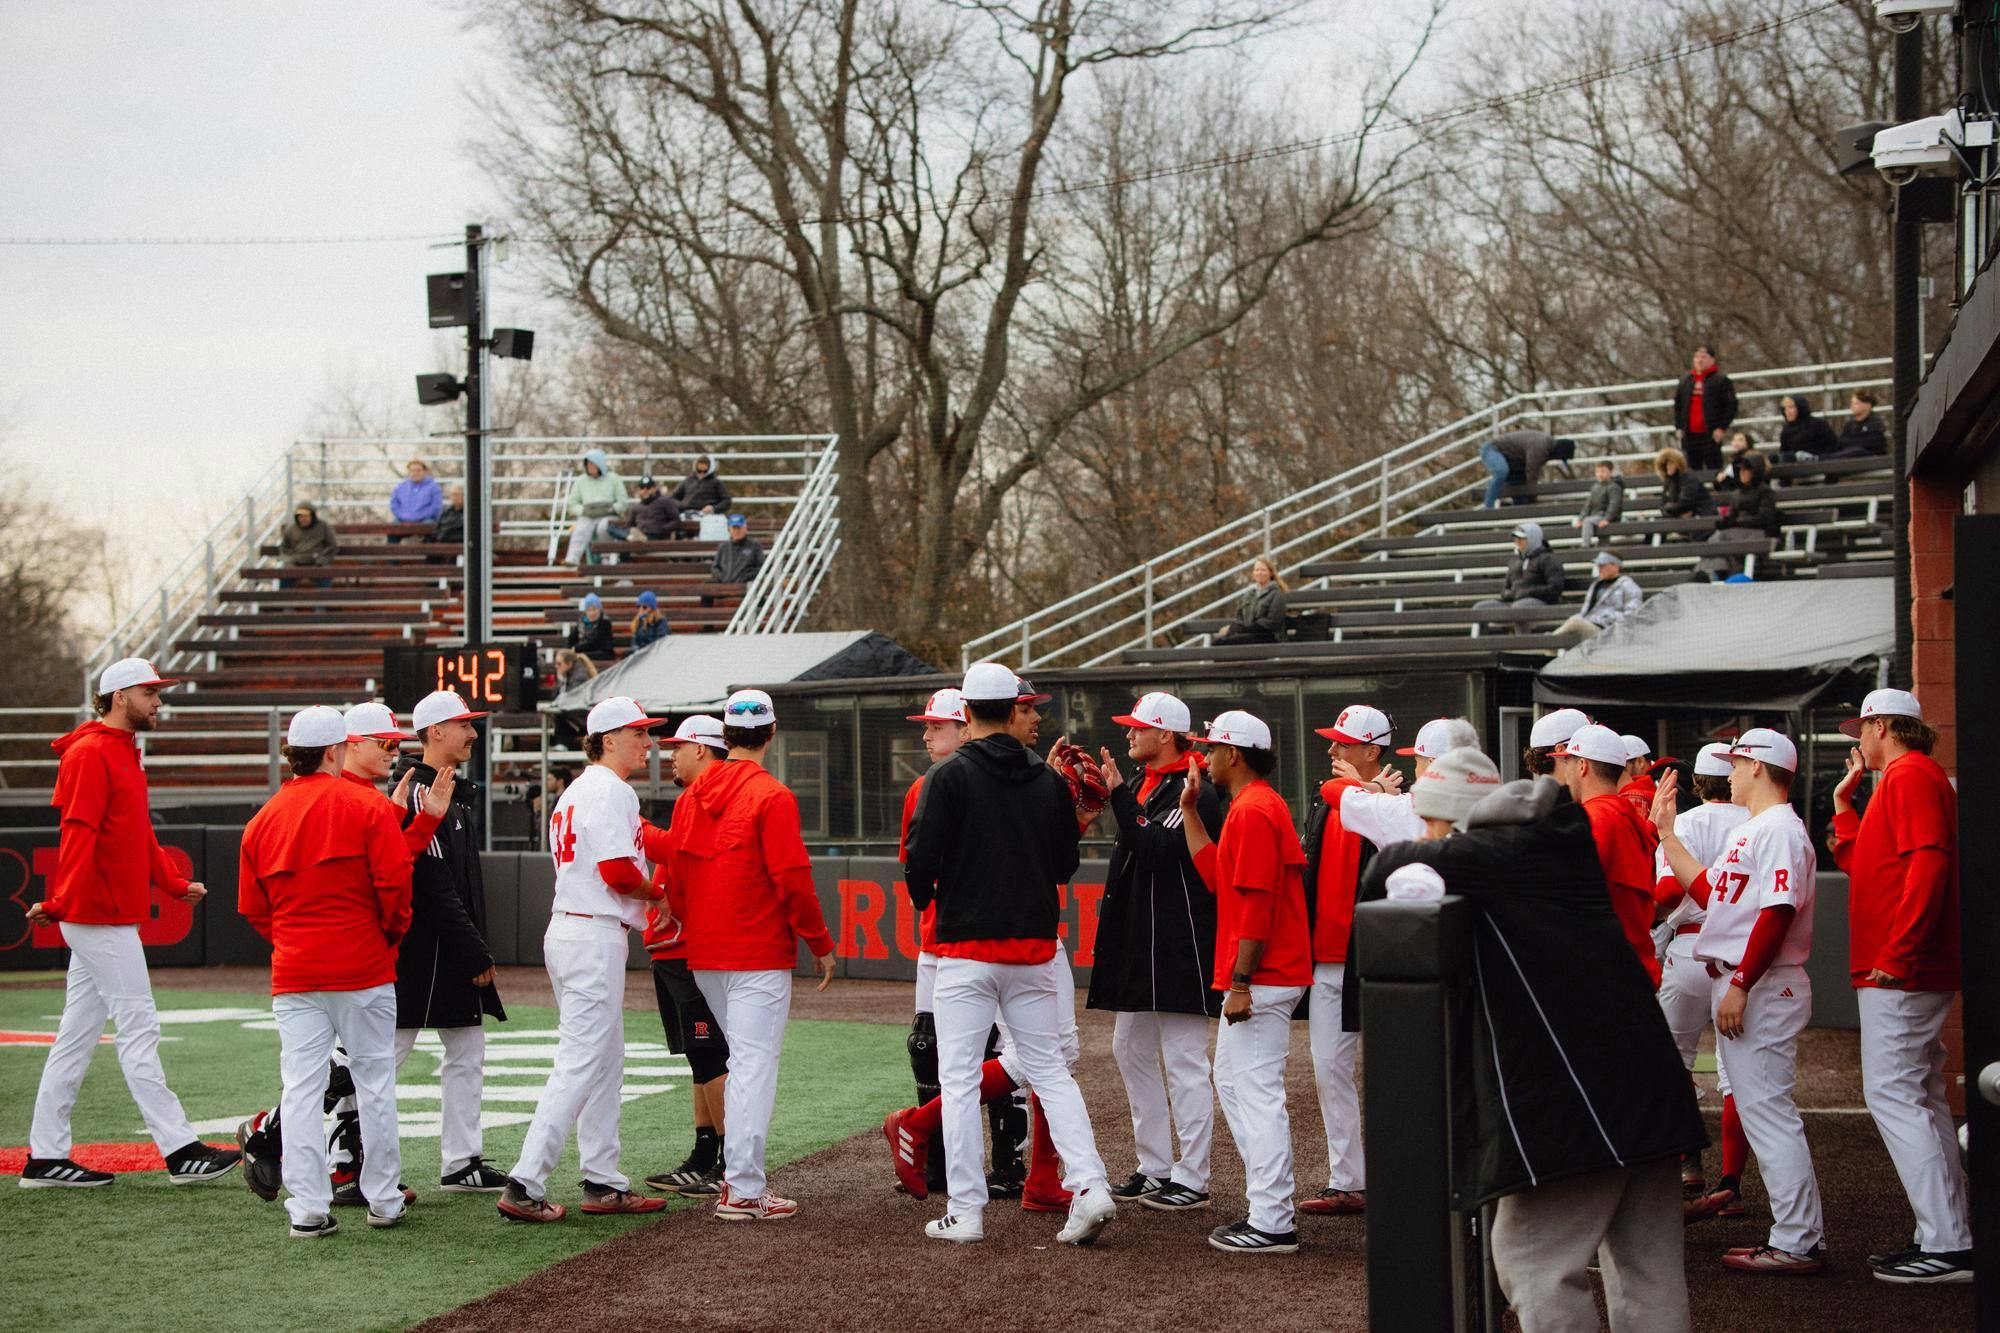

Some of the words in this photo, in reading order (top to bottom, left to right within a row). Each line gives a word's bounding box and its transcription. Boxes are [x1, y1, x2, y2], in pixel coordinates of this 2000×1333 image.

[437, 650, 505, 702] 1:42
[1336, 711, 1349, 728] R
[1714, 870, 1750, 905] 47
[1773, 868, 1790, 893] R
[694, 1021, 710, 1036] R
